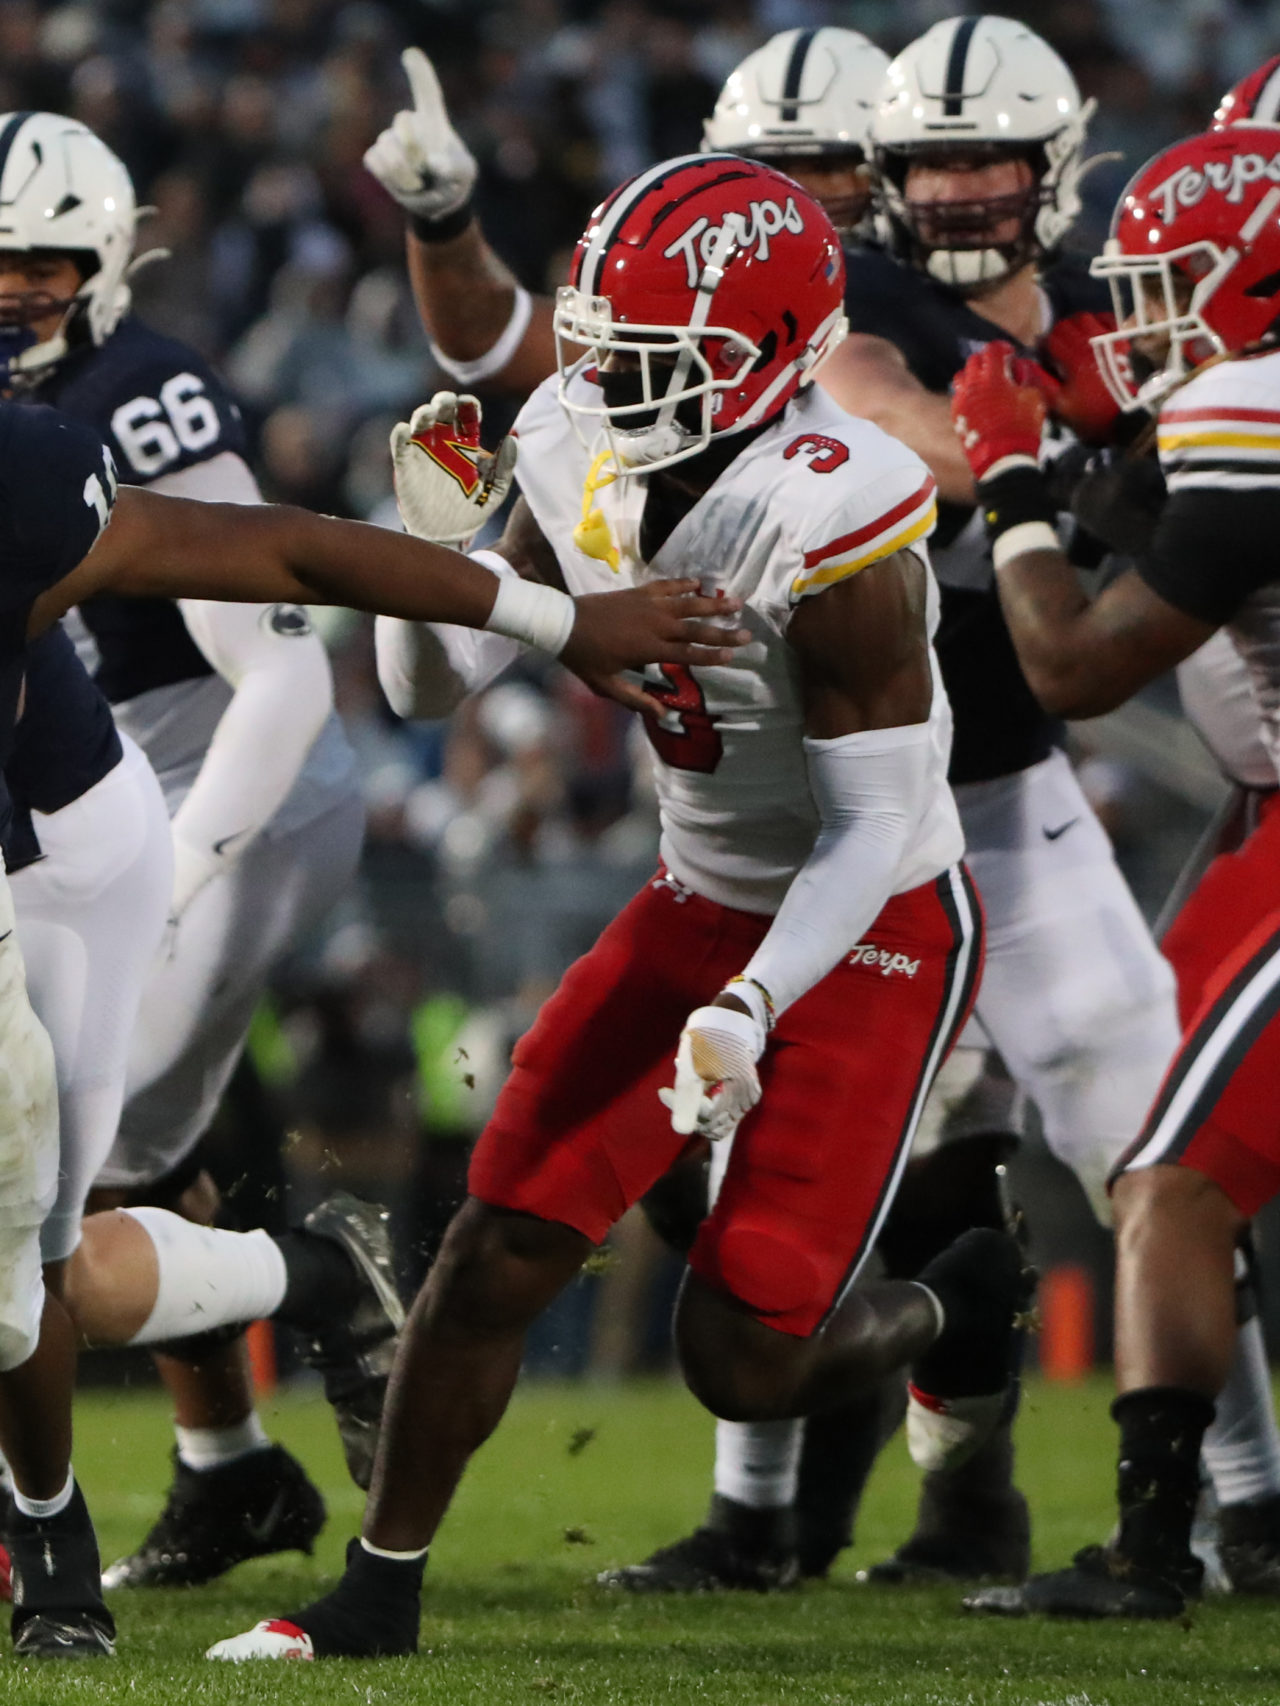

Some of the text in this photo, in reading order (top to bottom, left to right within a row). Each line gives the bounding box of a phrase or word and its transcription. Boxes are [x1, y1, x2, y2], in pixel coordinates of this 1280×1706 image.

[663, 196, 805, 289] Terps
[110, 371, 220, 476] 66
[782, 433, 850, 473] 3
[848, 944, 921, 976] Terps
